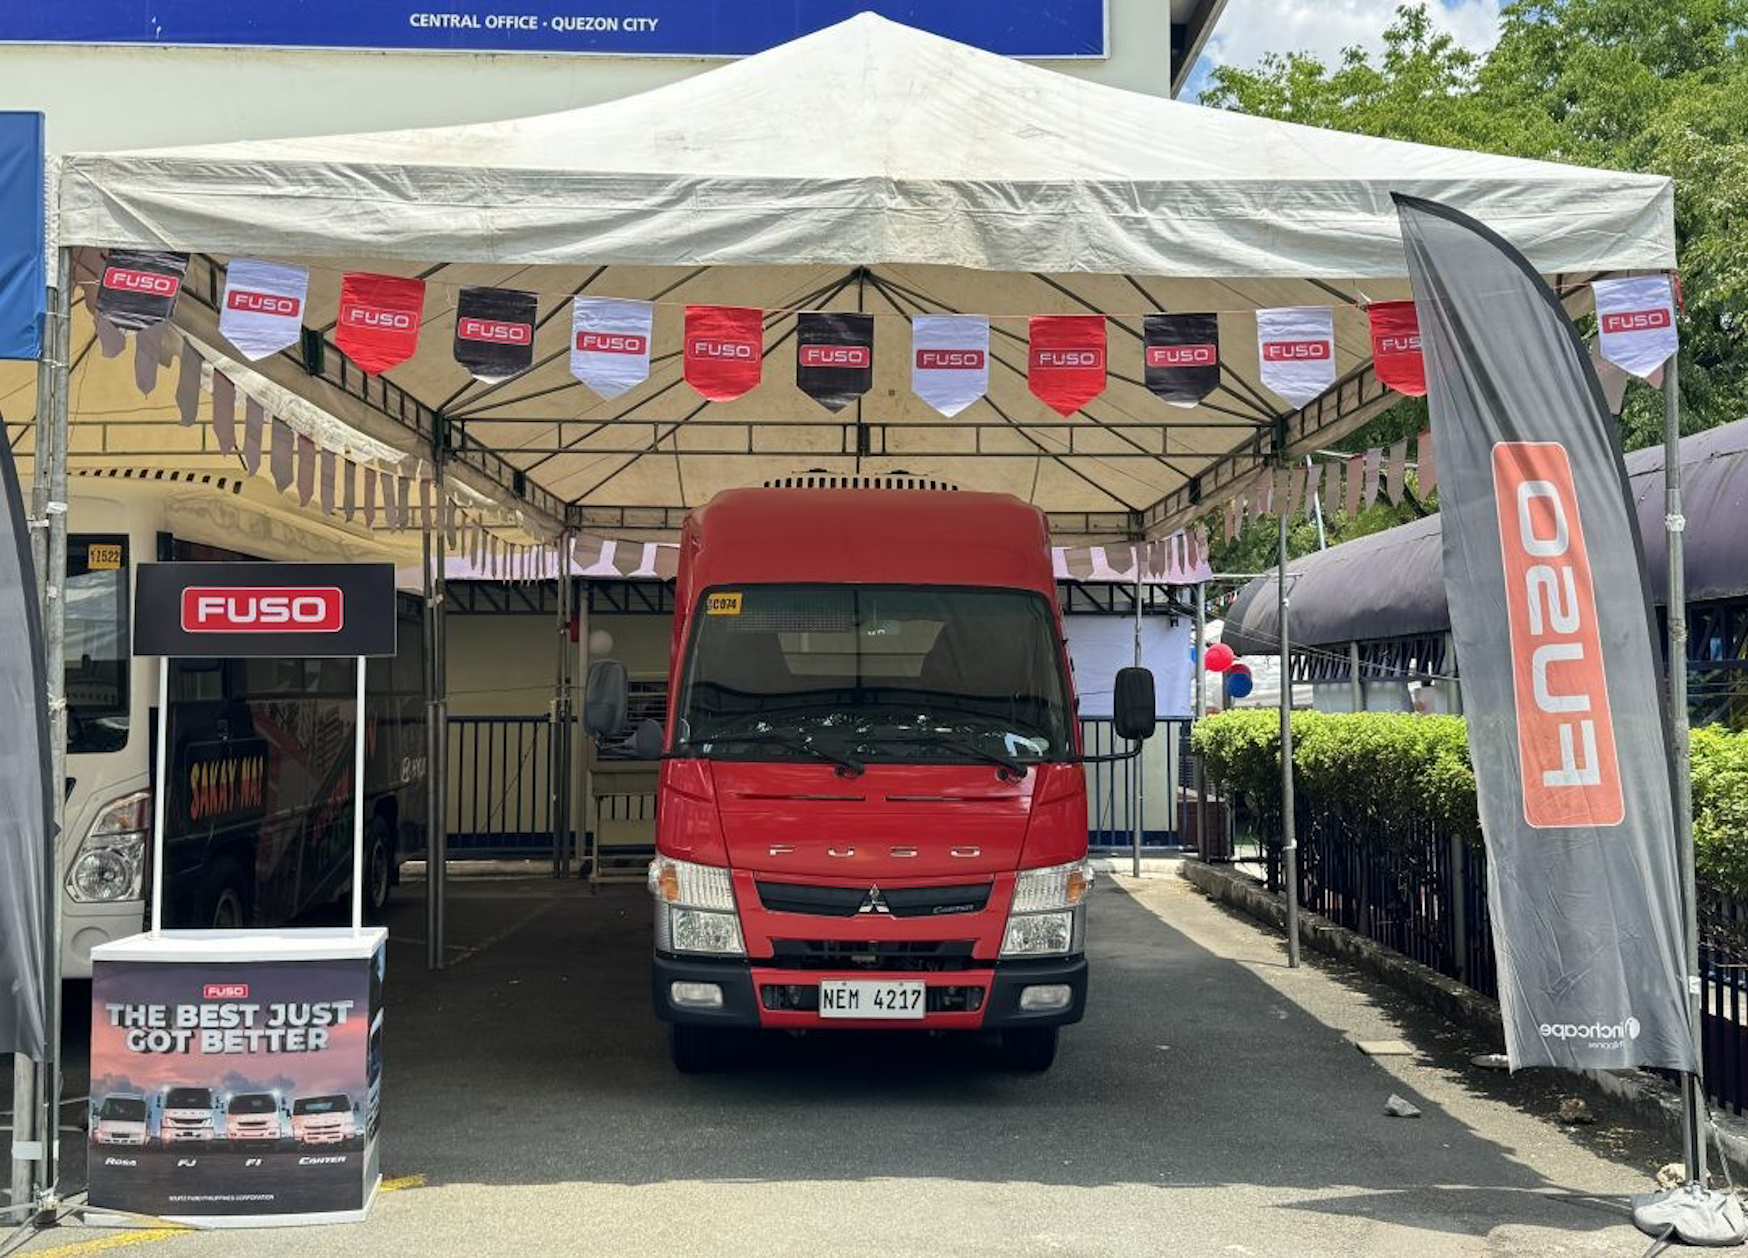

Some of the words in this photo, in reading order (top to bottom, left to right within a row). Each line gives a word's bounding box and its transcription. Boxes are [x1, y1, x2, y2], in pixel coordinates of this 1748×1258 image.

[409, 13, 481, 29] CENTRAL
[485, 14, 538, 30] OFFICE
[551, 16, 618, 32] QUEZON
[622, 17, 659, 32] CITY
[112, 271, 171, 292] FUSO
[234, 293, 293, 313] FUSO
[350, 309, 410, 328] FUSO
[1608, 311, 1665, 331] FUSO
[466, 322, 524, 341] FUSO
[583, 335, 640, 351] FUSO
[694, 341, 751, 358] FUSO
[1269, 343, 1324, 358] FUSO
[1382, 335, 1423, 352] FUS
[808, 348, 863, 364] FUSO
[923, 353, 979, 367] FUSO
[1039, 352, 1095, 366] FUSO
[1154, 348, 1209, 363] FUSO
[197, 596, 327, 624] FUSO
[770, 844, 980, 858] FUSO
[207, 986, 244, 997] FUSO
[822, 989, 859, 1010] NEM
[874, 989, 922, 1010] 4217
[105, 1003, 167, 1027] THE
[176, 1003, 260, 1029] BEST
[268, 1000, 354, 1026] JUST
[127, 1029, 193, 1053] GOT
[203, 1027, 330, 1055] BETTER
